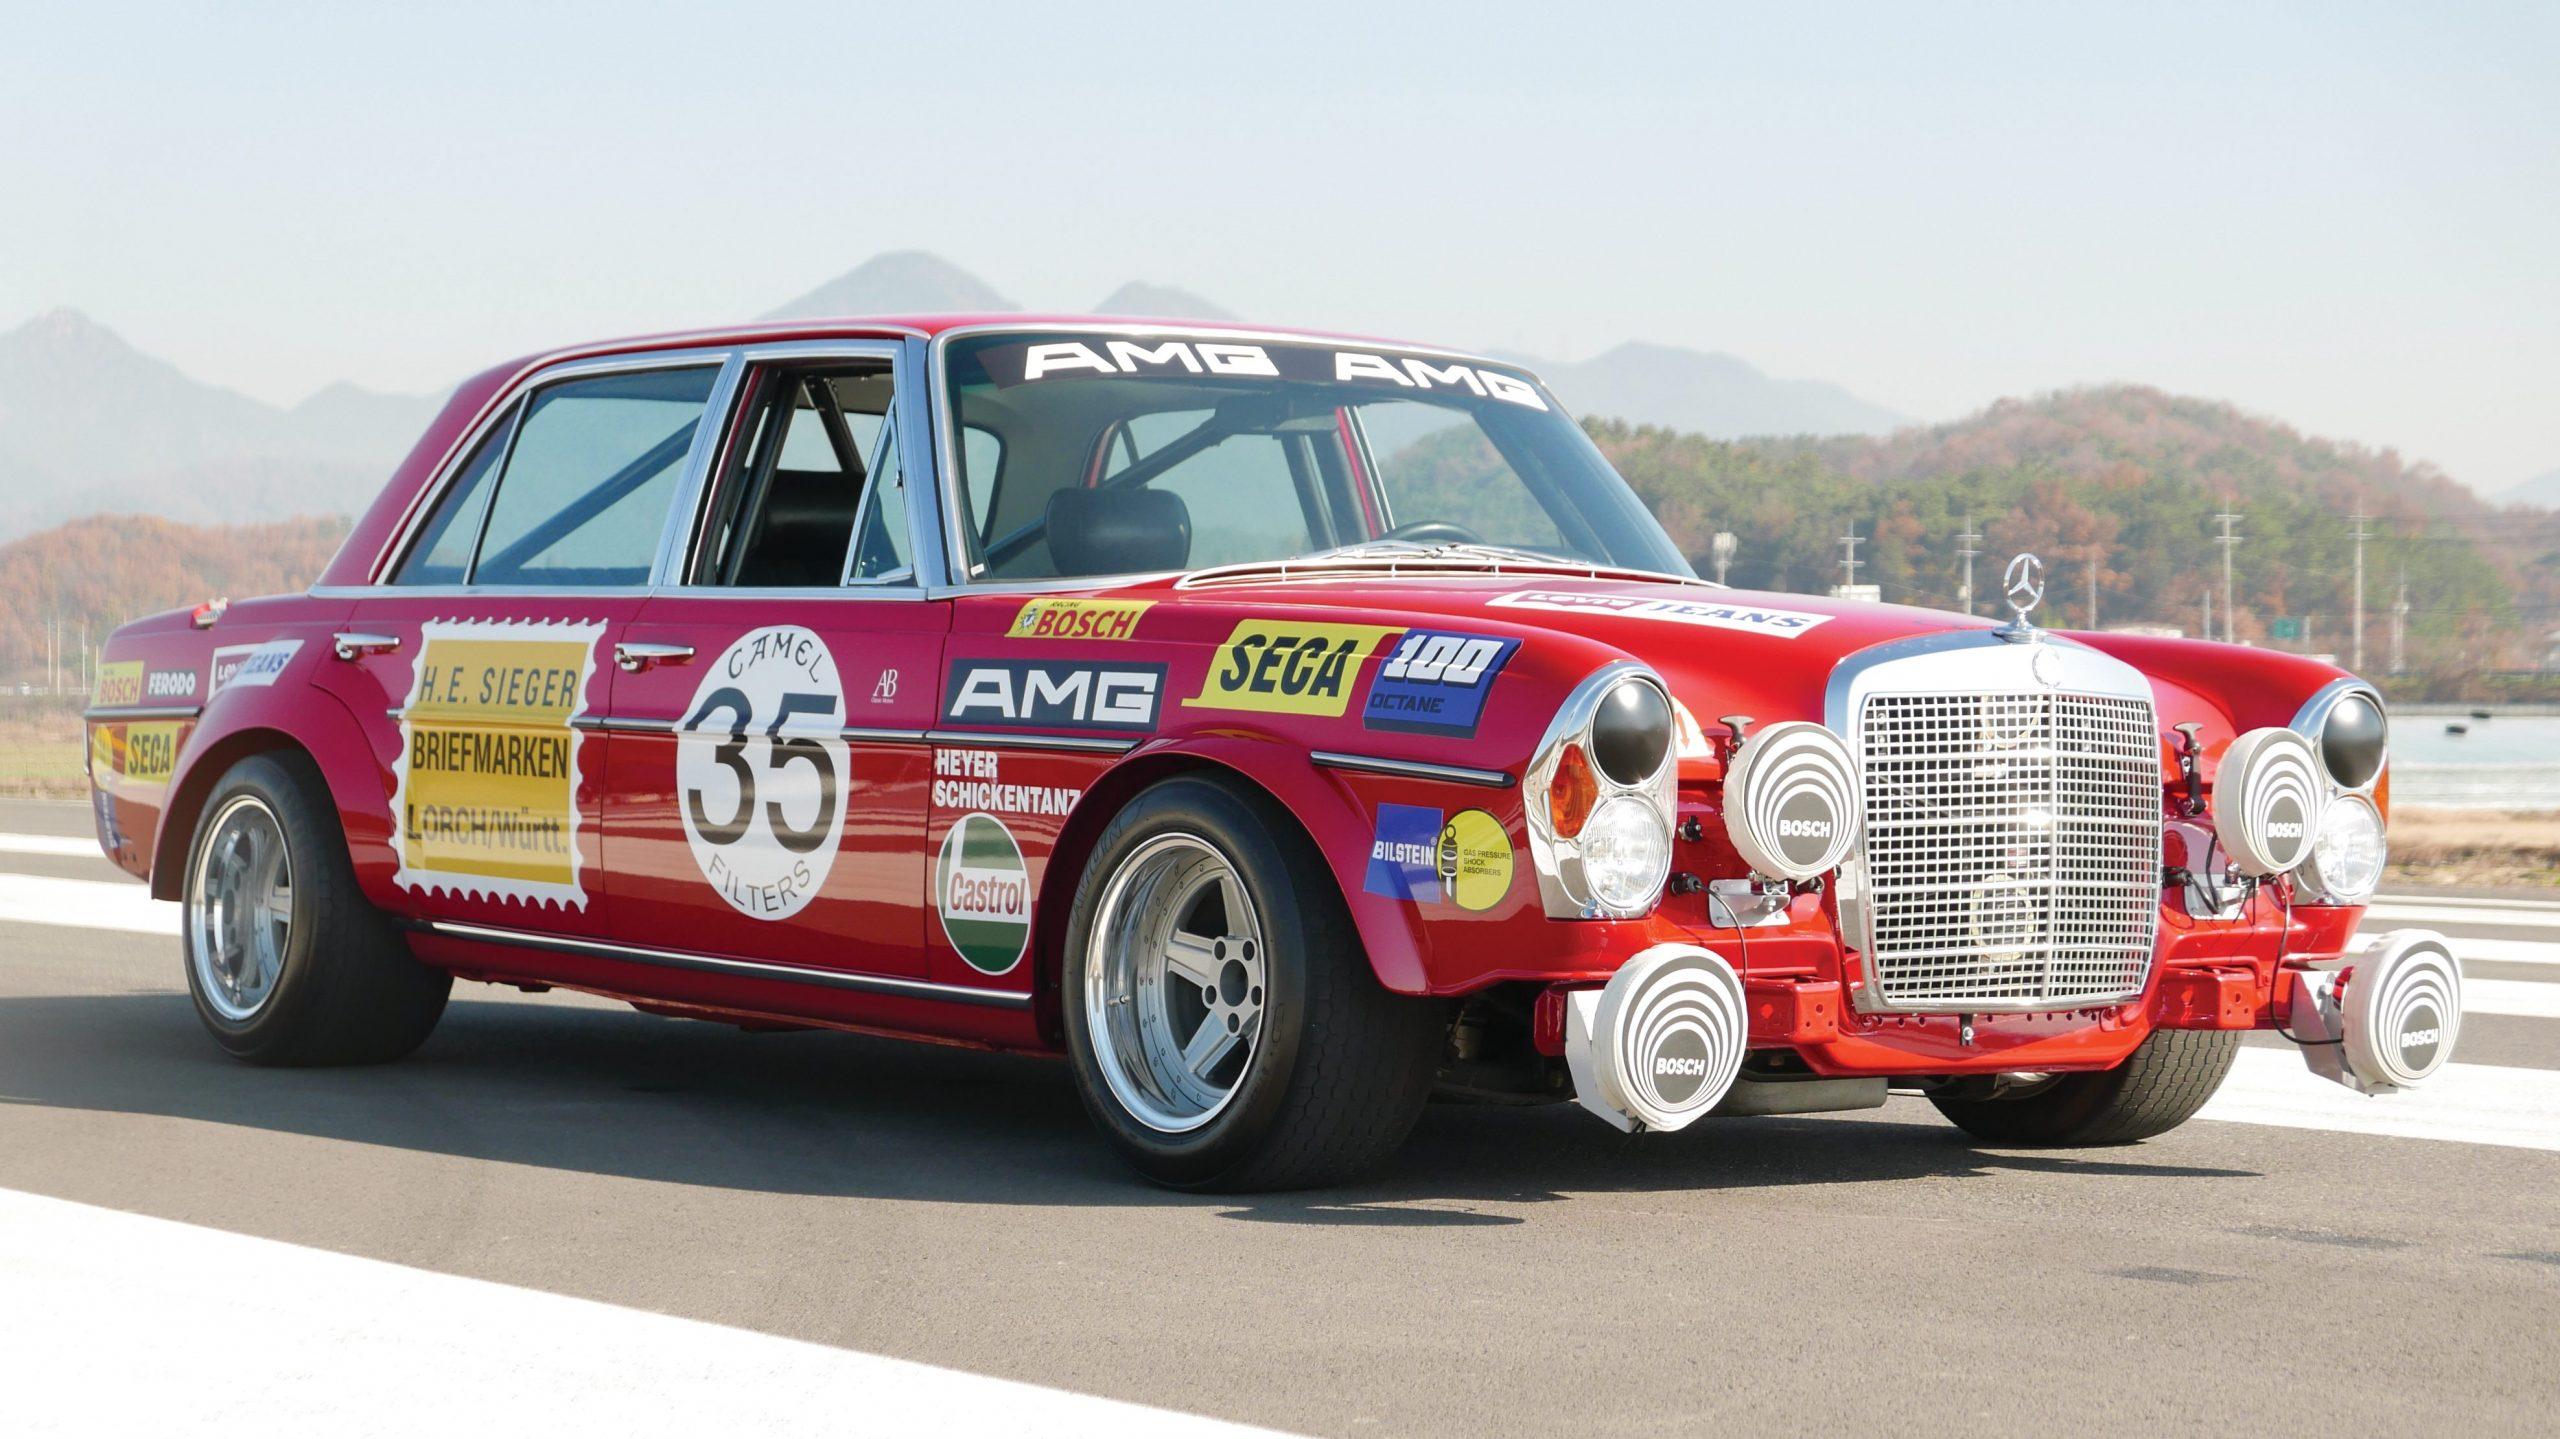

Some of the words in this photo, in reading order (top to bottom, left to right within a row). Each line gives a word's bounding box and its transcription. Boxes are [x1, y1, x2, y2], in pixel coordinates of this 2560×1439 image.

[1024, 342, 1280, 380] AMG
[1334, 352, 1550, 411] AMG
[1032, 609, 1138, 638] BOSCH
[1648, 603, 1810, 628] JEANS
[728, 632, 822, 683] CAMEL
[1383, 634, 1504, 685] 100
[99, 677, 138, 703] BOSCH
[148, 672, 196, 696] FERODO
[419, 666, 468, 703] H.E.
[480, 667, 577, 707] SIEGER
[872, 669, 898, 697] AB
[950, 668, 1158, 723] AMG
[1370, 693, 1445, 713] OCTANE
[412, 731, 568, 778] BRIEFMARKEN
[936, 749, 998, 778] HEYER
[684, 687, 837, 853] 35
[934, 780, 1081, 816] SCHICKENTANZ
[1780, 819, 1831, 837] BOSCH
[2267, 822, 2303, 838] BOSCH
[1372, 841, 1435, 866] BILSTEIN
[1463, 849, 1476, 857] GAS
[1478, 850, 1511, 860] PRESSURE
[1463, 858, 1486, 866] SHOCK
[709, 853, 811, 912] FILTERS
[1463, 867, 1502, 877] ABSORBERS
[951, 872, 1026, 915] Castrol
[2401, 1028, 2439, 1047] BOSCH
[1655, 1057, 1706, 1076] BOSCH
